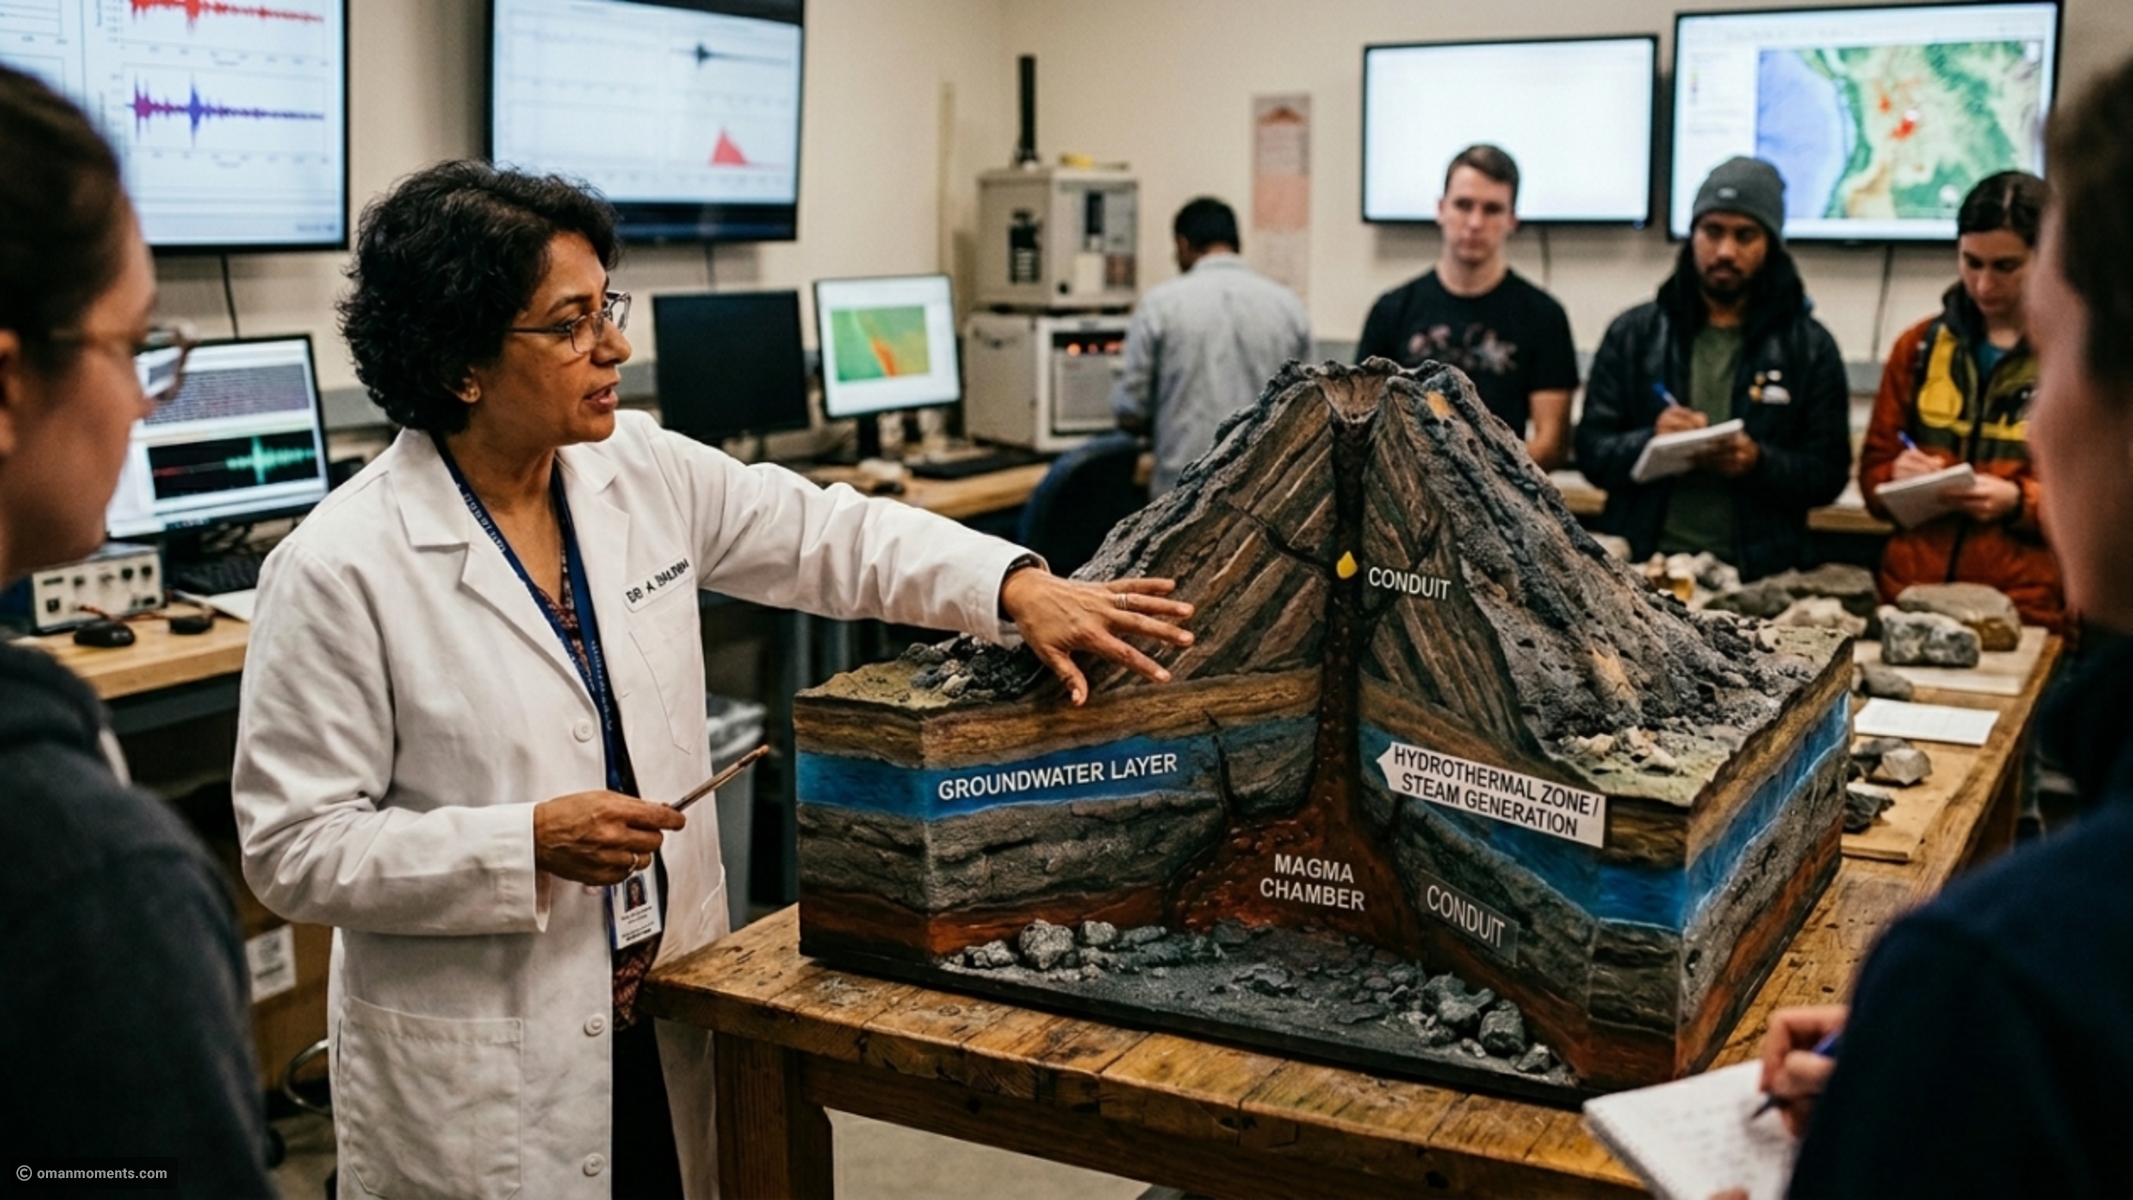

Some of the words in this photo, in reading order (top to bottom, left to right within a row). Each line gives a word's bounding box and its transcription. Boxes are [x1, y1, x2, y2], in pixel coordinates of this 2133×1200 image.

[1368, 565, 1452, 601] CONDUIT
[937, 761, 1106, 801] GROUNDWATER
[1110, 752, 1178, 779] LAYER
[1394, 745, 1537, 803] HYDROTHERMAL
[1401, 772, 1461, 805] STEAM
[1463, 789, 1579, 838] GENERATION
[1275, 854, 1354, 883] MAGMA
[1260, 878, 1365, 910] CHAMBER
[1427, 885, 1505, 948] CONDUIT
